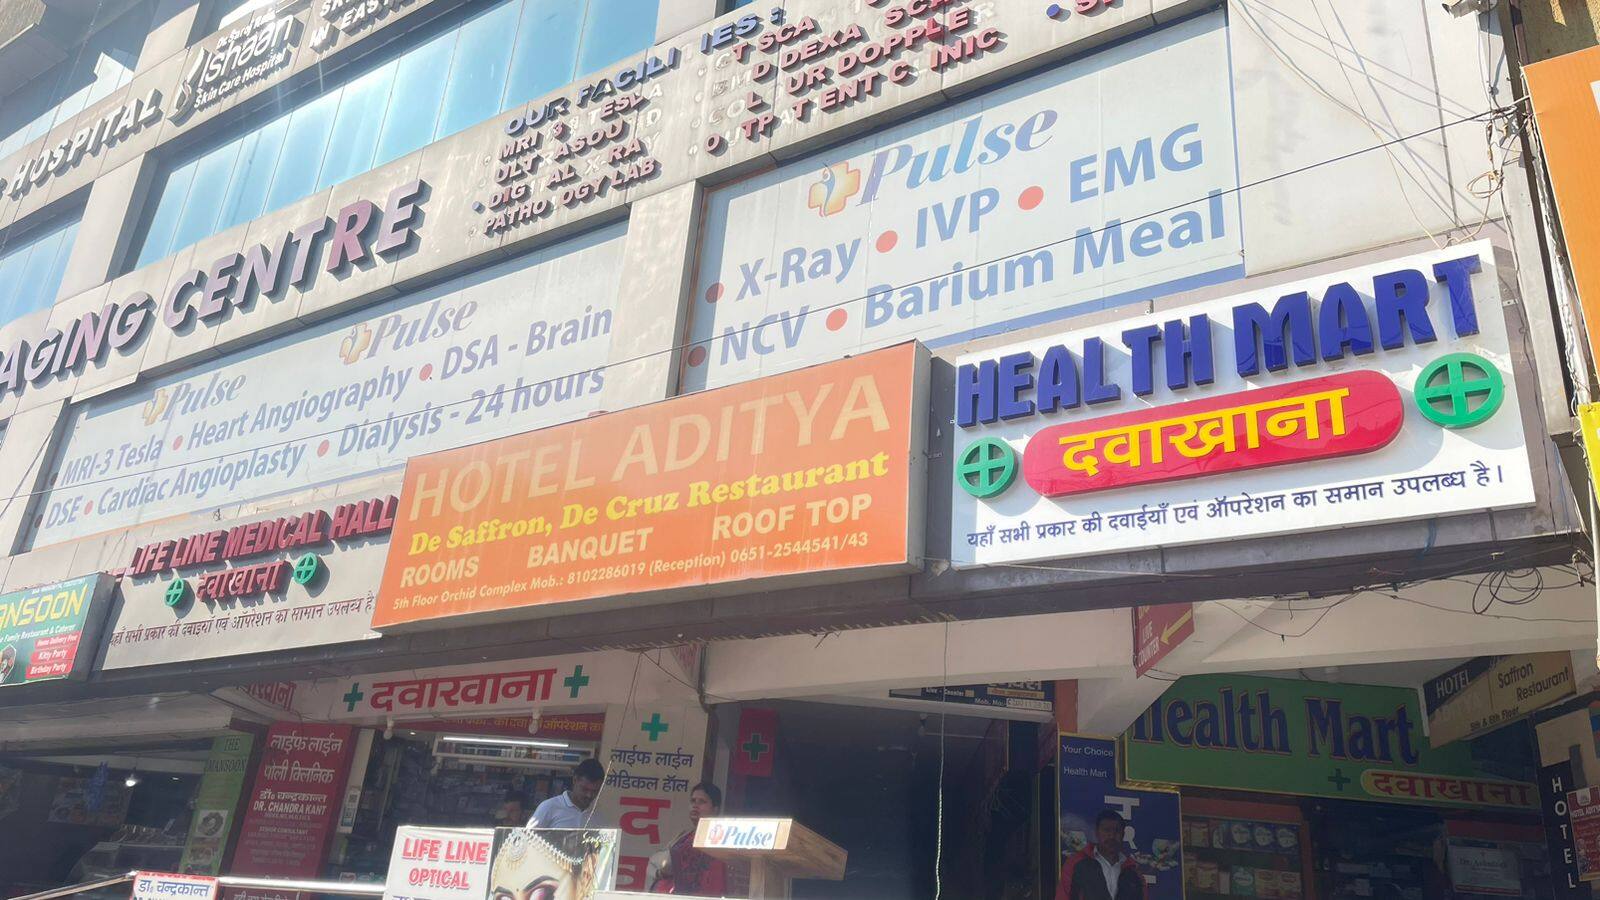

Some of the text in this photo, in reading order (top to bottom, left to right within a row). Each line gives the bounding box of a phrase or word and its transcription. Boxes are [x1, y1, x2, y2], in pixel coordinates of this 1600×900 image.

[194, 48, 286, 108] Skin Care Hospital
[199, 15, 294, 87] Ishaan
[7, 88, 158, 197] HOSPITAL
[506, 97, 567, 136] OUR
[611, 157, 657, 188] LAB
[856, 109, 1058, 208] Pulse
[1069, 123, 1204, 203] EMG
[164, 180, 424, 329] CENTRE
[736, 187, 1000, 302] X-Ray IVP
[720, 189, 1226, 367] NCV Barium Meal
[366, 300, 478, 359] Pulse
[955, 254, 1482, 428] HEALTH MART
[61, 452, 112, 487] MRI-3
[116, 435, 164, 471] Tesla
[187, 411, 250, 450] Heart
[250, 365, 414, 434] Angiography
[441, 334, 499, 381] DSA
[525, 305, 613, 357] Brain
[162, 371, 247, 421] Pulse
[45, 496, 83, 530] DSE
[97, 475, 167, 516] Cardiac
[170, 441, 307, 498] Angioplasty
[338, 403, 444, 458] Dialysis
[464, 384, 505, 425] 24
[511, 368, 605, 415] hours
[409, 374, 891, 522] HOTEL ADITYA
[1060, 387, 1350, 477] दवाखाना
[408, 451, 890, 556] De Saffron, De Cruz Restaurant
[967, 523, 996, 548] यहाँ
[999, 520, 1031, 544] सभी
[1036, 519, 1077, 540] प्रकार
[1082, 511, 1103, 533] की
[1174, 499, 1200, 524] एवं
[1206, 491, 1286, 519] ऑपरेशन
[1292, 489, 1318, 509] का
[1324, 480, 1385, 504] समान
[1391, 469, 1467, 496] उपलब्ध
[129, 494, 400, 578] LIFE LINE MEDICAL HALL
[400, 493, 873, 588] ROOMS BANQUET ROOF TOP
[393, 596, 410, 610] 5th
[412, 593, 438, 609] Floor
[441, 587, 477, 604] Orchid
[479, 580, 528, 601] Complex
[567, 561, 646, 584] 8102286019
[649, 552, 726, 578] (Reception)
[730, 531, 869, 564] 0651-2544541/43
[370, 667, 558, 712] दवाखाना
[1436, 669, 1472, 699] HOTEL
[1497, 662, 1535, 689] Saffron
[1516, 666, 1570, 701] Restaurant
[271, 730, 343, 757] लाईफ लाईन
[610, 745, 695, 771] लाईफ लाईन
[1062, 744, 1114, 758] Your Choice
[1302, 694, 1423, 768] Mart
[605, 769, 690, 793] मेडिकल हॉल
[1063, 766, 1108, 778] Health Mart
[1371, 771, 1533, 806] दवाखाना
[268, 803, 304, 815] CHANDRA
[305, 804, 328, 816] KANT
[721, 825, 774, 847] Pulse
[1551, 776, 1577, 889] HOTEL
[402, 837, 490, 864] LIFE LINE
[408, 867, 471, 890] OPTICAL
[156, 880, 212, 898] चन्द्रकान्त
